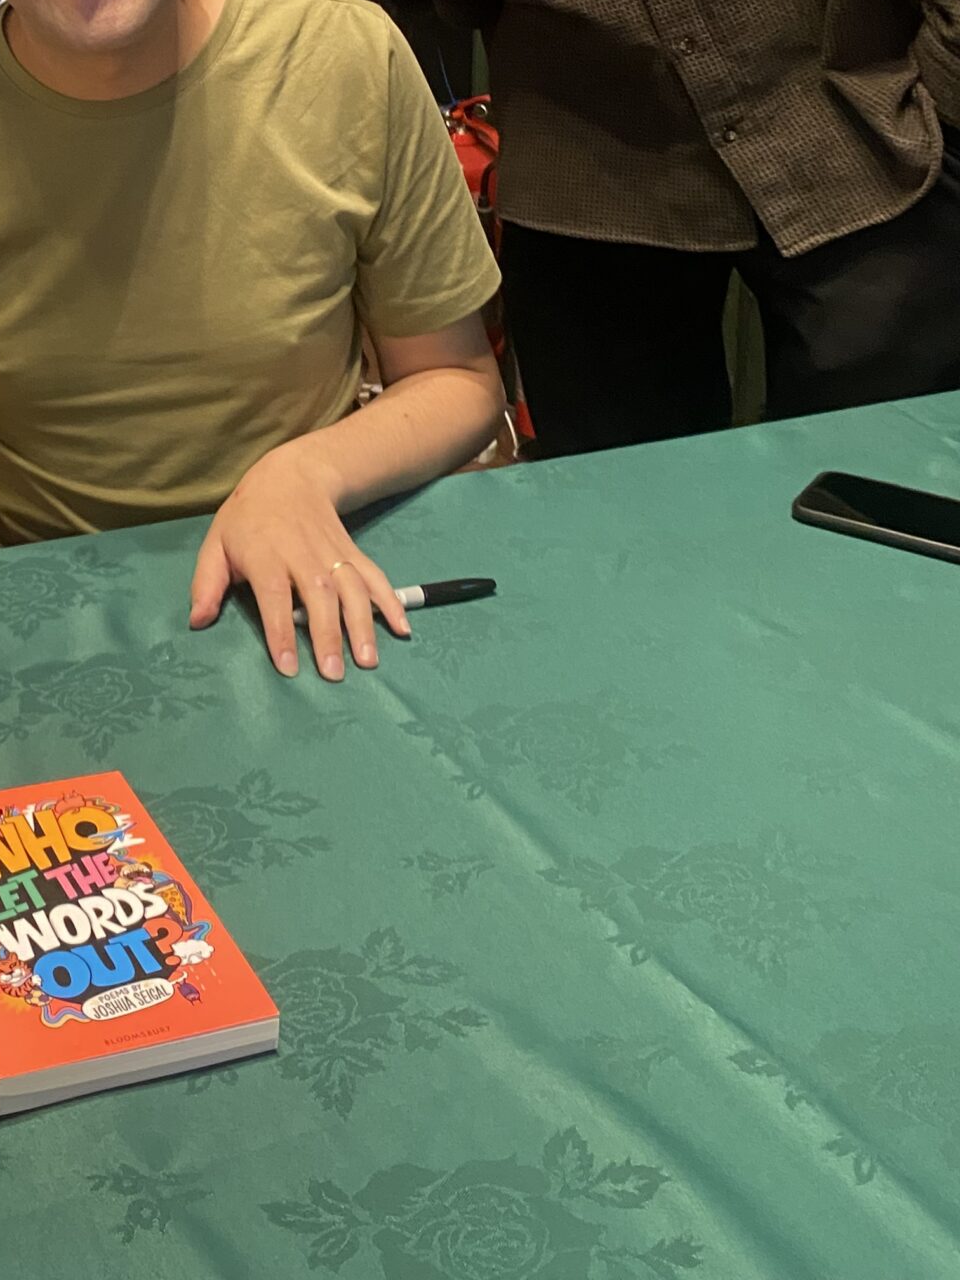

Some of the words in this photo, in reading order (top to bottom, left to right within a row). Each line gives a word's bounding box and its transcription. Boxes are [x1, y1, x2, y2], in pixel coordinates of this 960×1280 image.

[44, 852, 118, 900] THE
[34, 917, 183, 998] OUT?
[98, 989, 130, 1003] POEMS
[133, 984, 142, 992] BY
[93, 999, 137, 1019] JOSHUA
[104, 1025, 171, 1046] BLOOMSBURY
